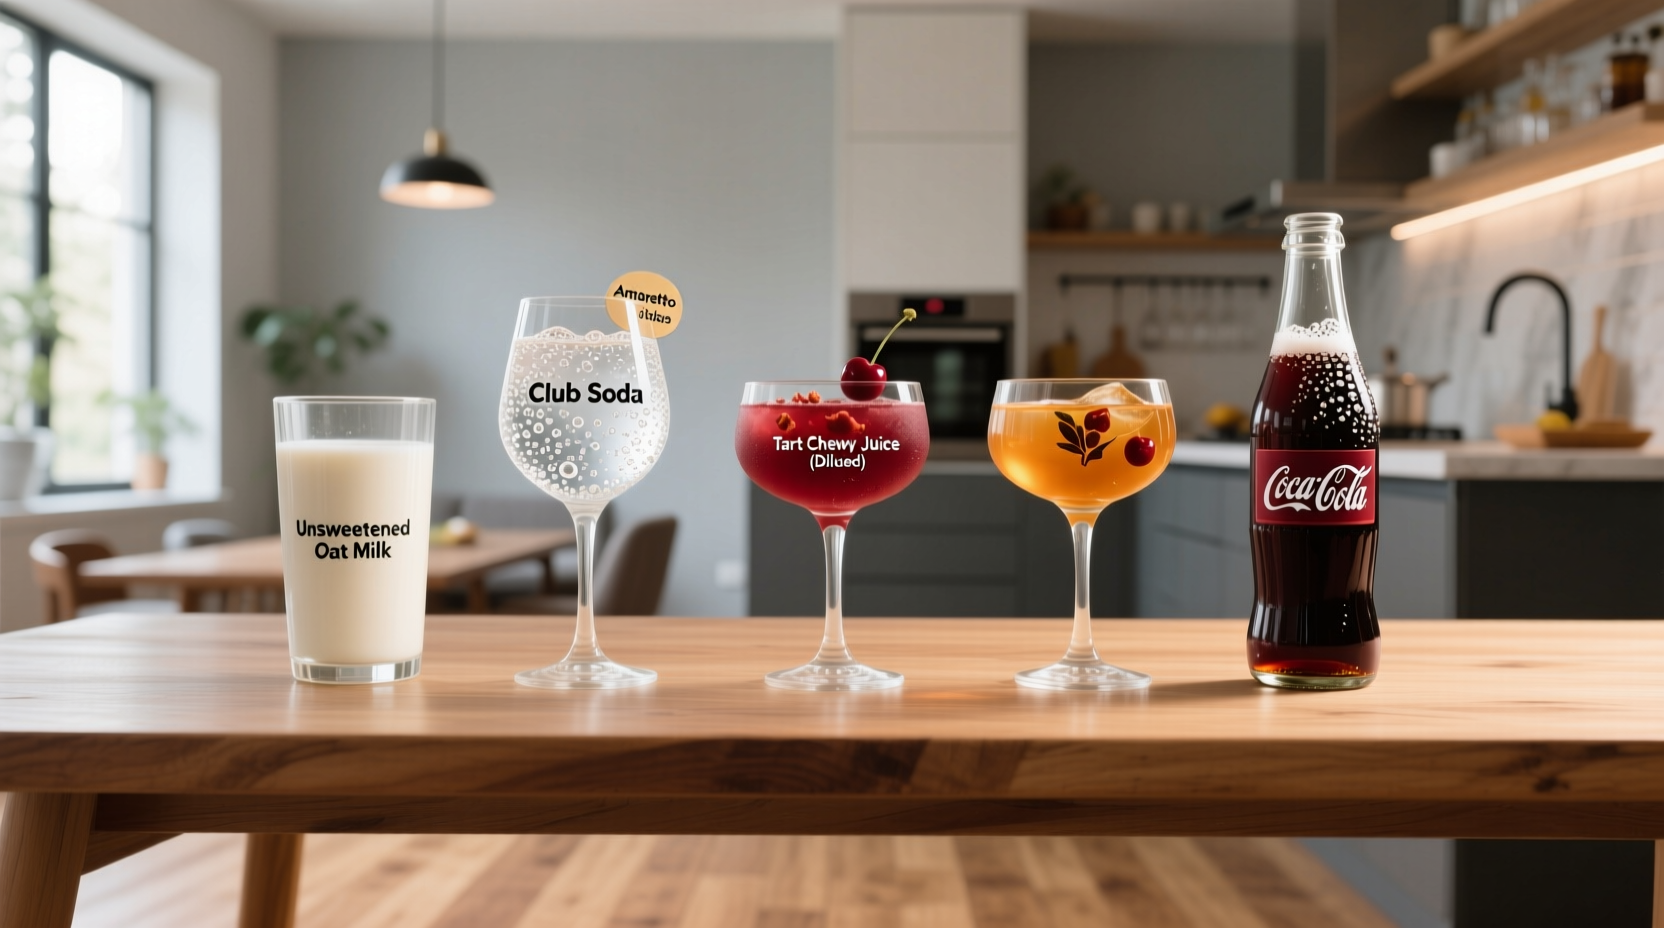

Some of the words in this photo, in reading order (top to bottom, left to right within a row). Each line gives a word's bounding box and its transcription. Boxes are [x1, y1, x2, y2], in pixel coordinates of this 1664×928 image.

[613, 284, 676, 308] Amaretto
[528, 382, 582, 403] Club
[587, 382, 643, 404] Soda
[772, 435, 803, 451] Tart
[860, 435, 901, 451] Juice
[296, 518, 410, 537] Unsweetened
[314, 541, 349, 559] Oat
[353, 540, 392, 559] Milk
